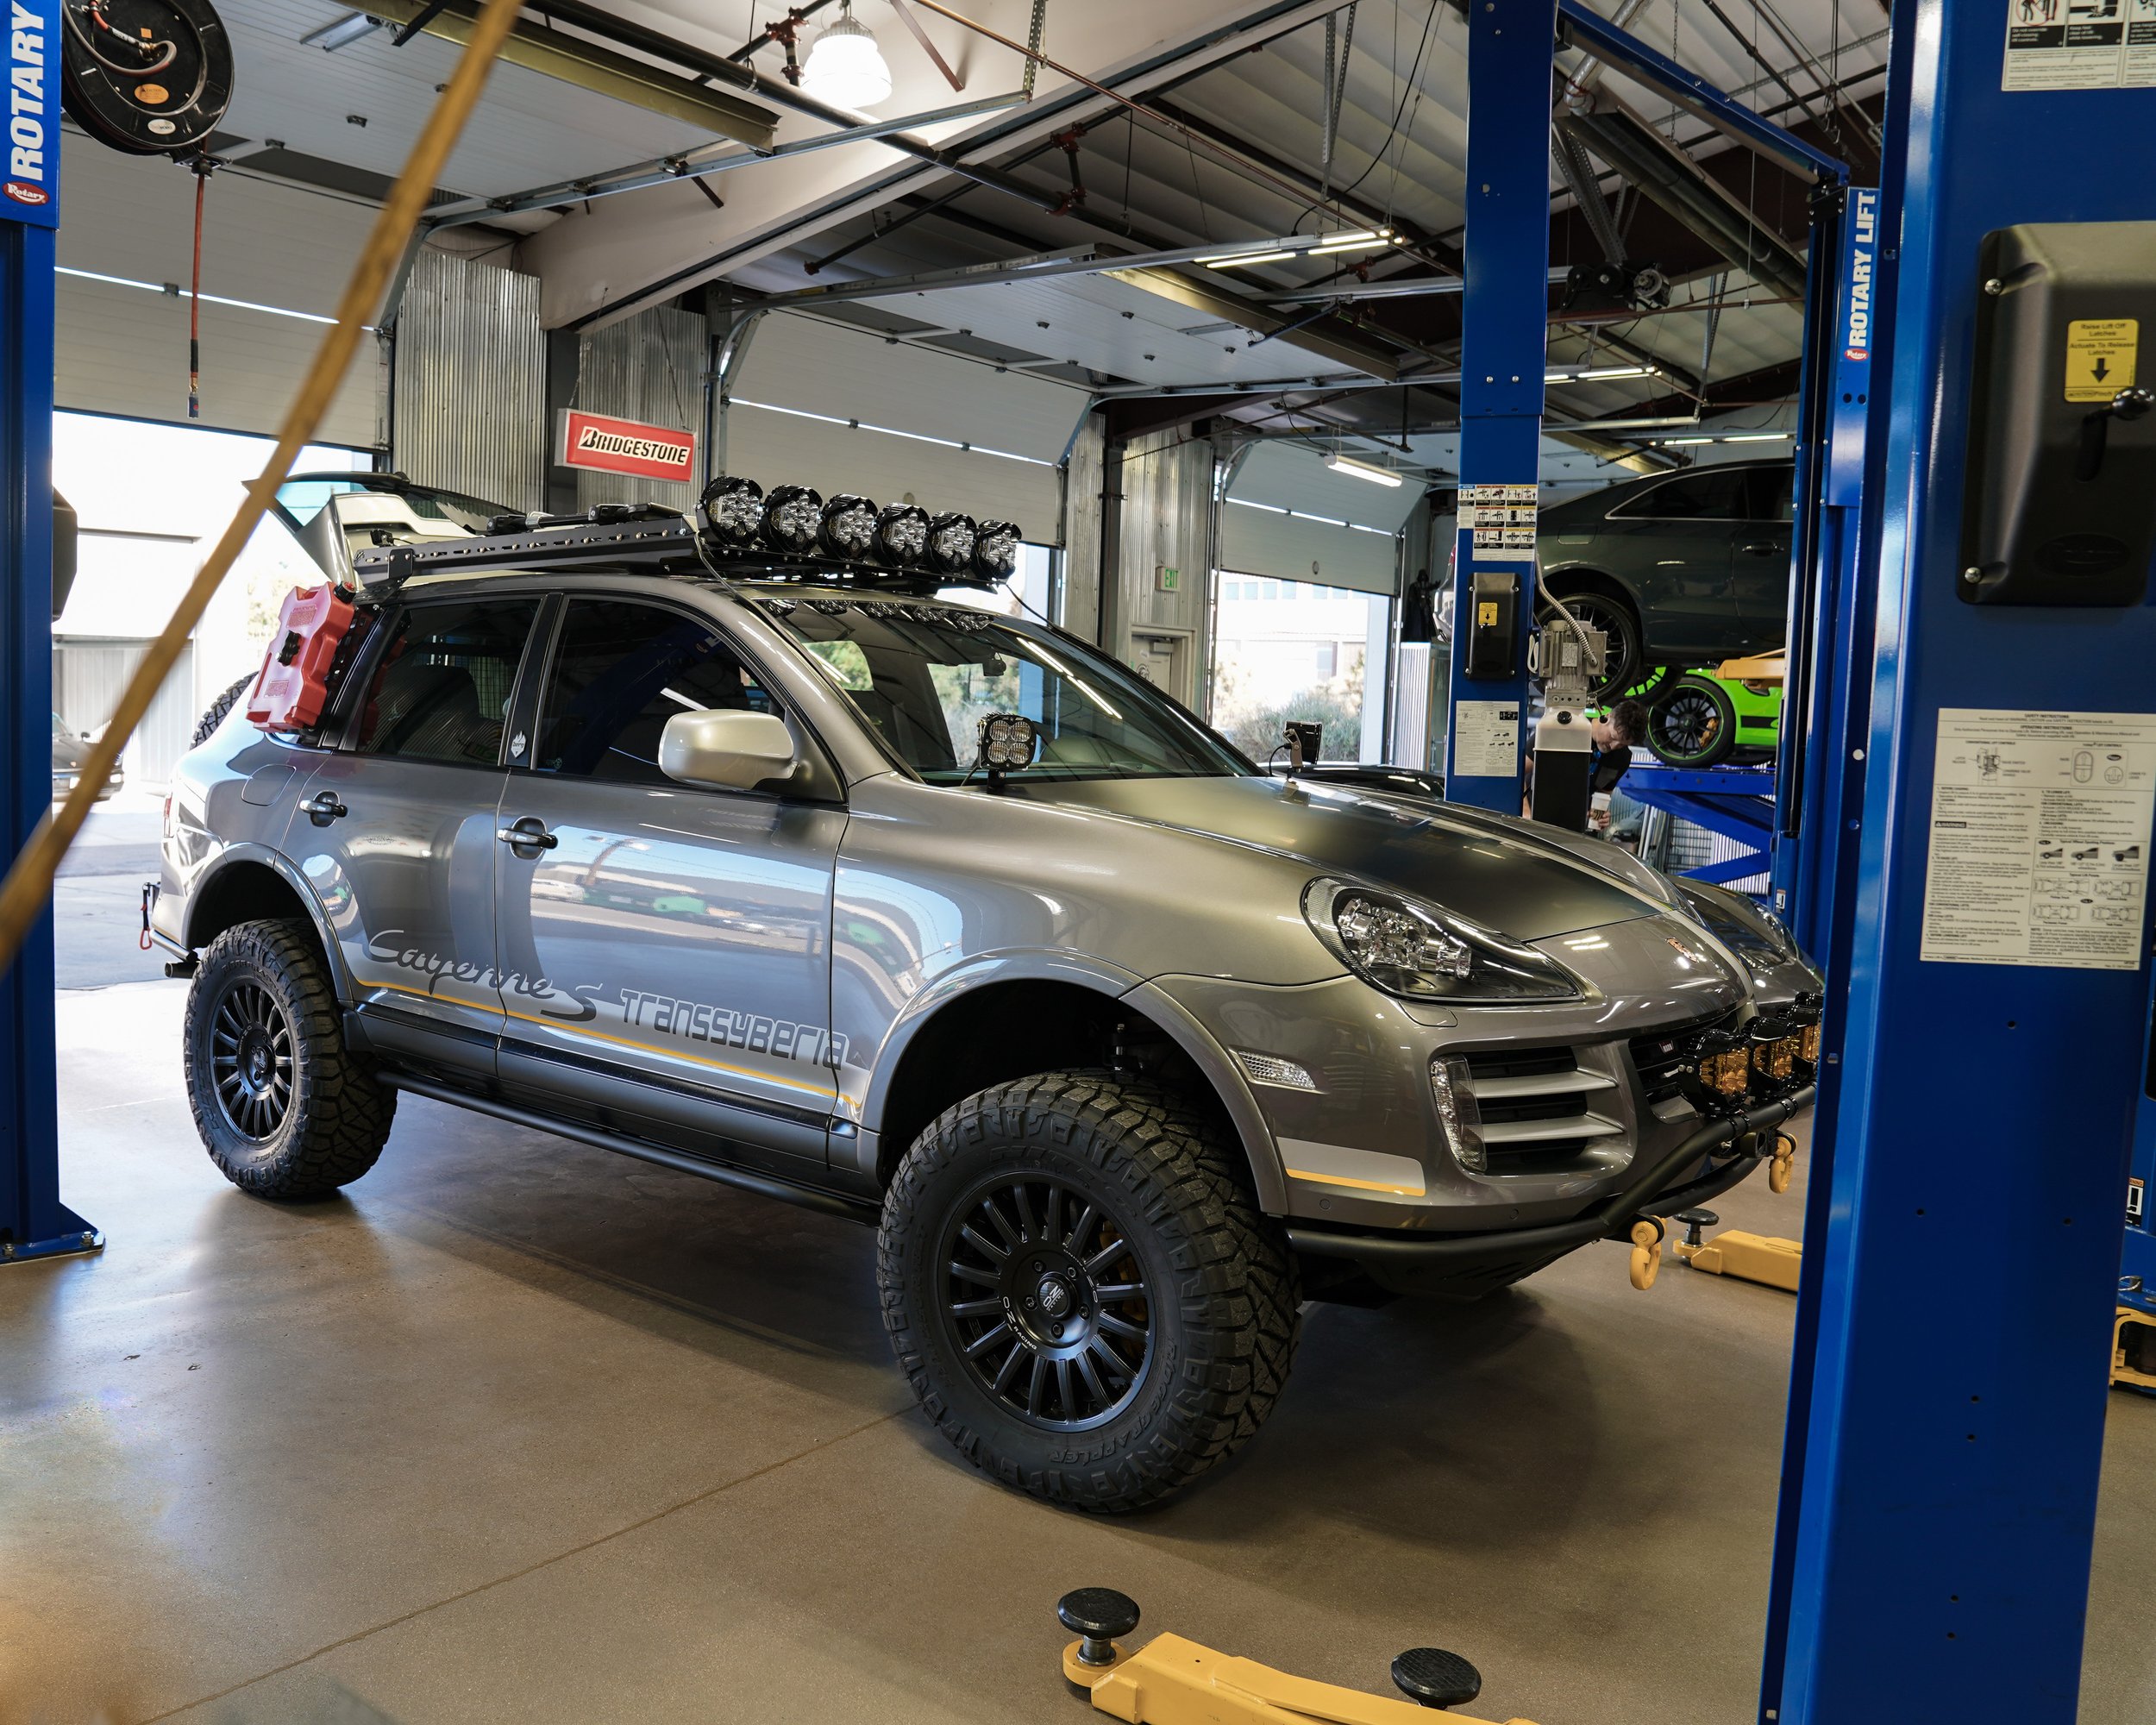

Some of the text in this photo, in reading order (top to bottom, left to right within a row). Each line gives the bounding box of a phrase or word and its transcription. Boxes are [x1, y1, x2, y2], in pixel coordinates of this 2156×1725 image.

[10, 0, 44, 181] ROTARY
[8, 183, 45, 203] Rotary
[1849, 191, 1876, 347] ROTARY LIFT
[580, 429, 688, 464] BRIDGESTONE
[1164, 568, 1179, 589] EXIT
[368, 929, 603, 1022] Cayenne S
[1013, 1326, 1037, 1351] RACING
[1049, 1411, 1153, 1467] GRAPPLER
